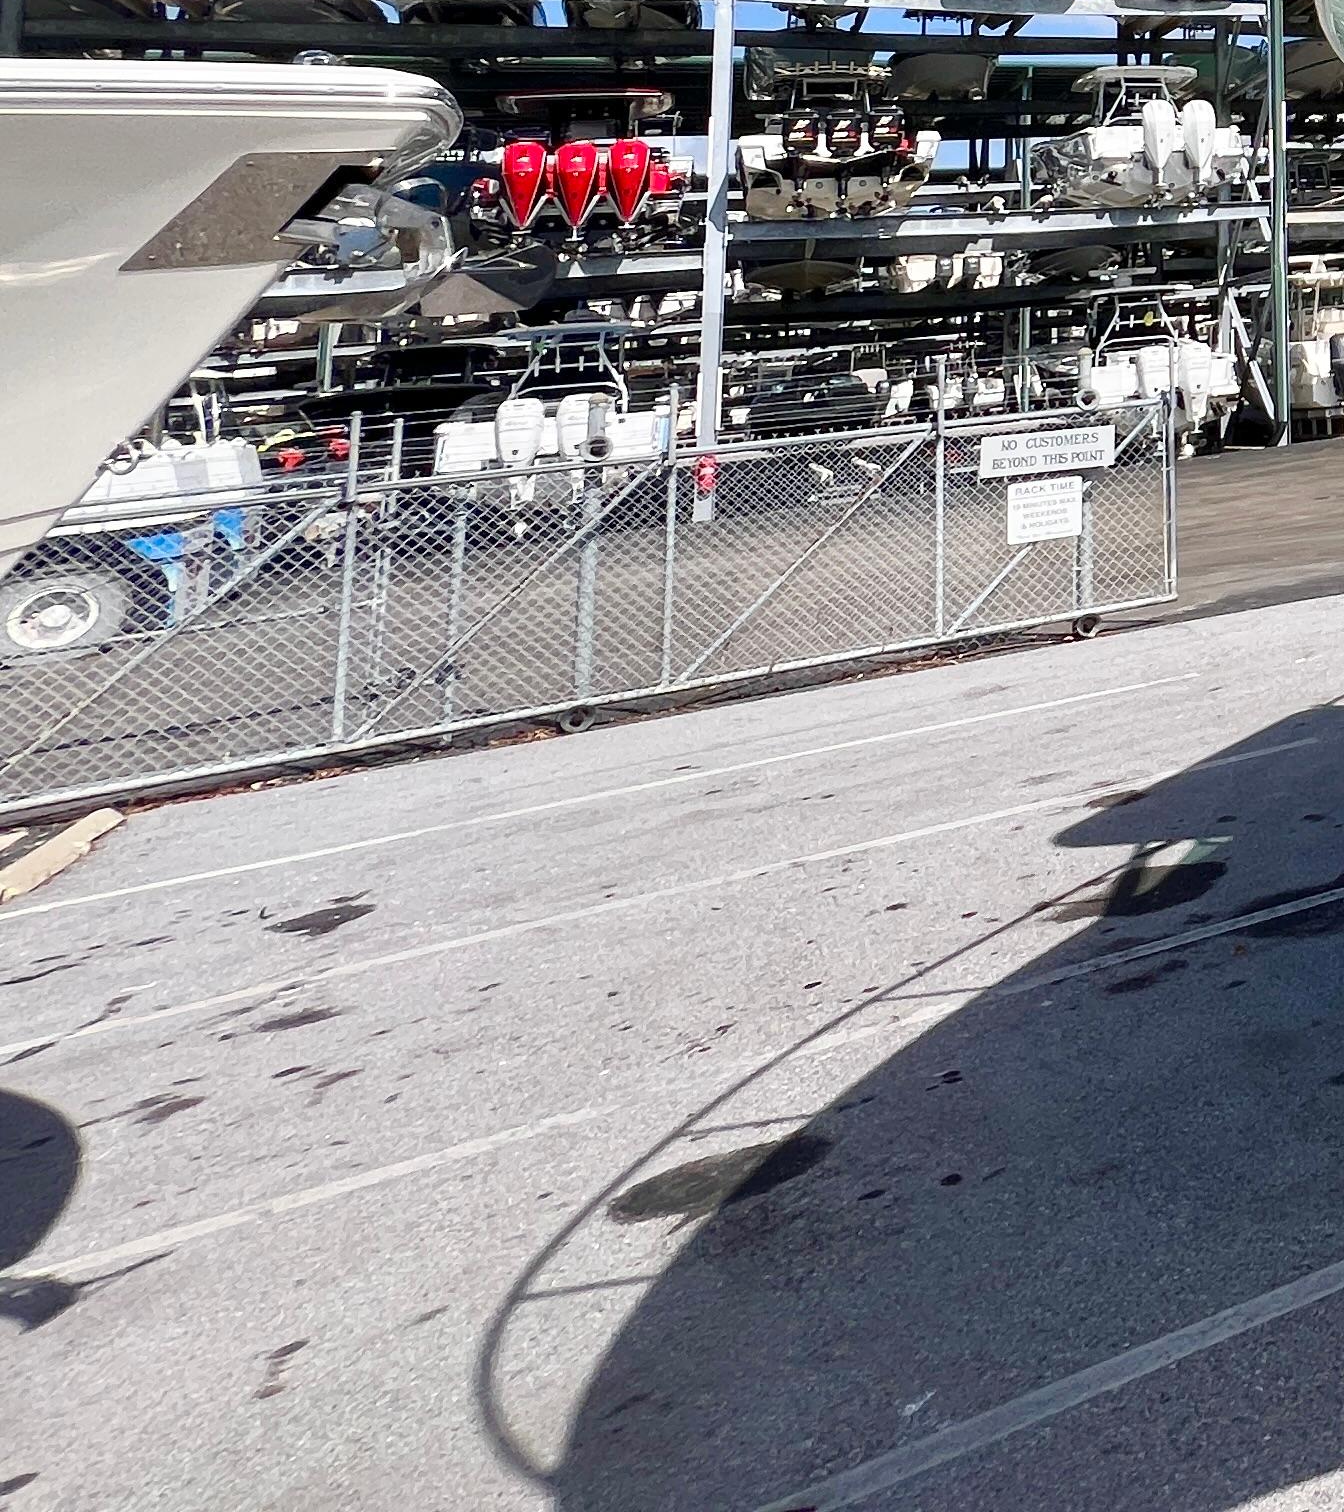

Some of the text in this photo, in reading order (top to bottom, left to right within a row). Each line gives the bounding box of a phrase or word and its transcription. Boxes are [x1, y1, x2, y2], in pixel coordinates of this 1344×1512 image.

[1001, 433, 1099, 452] NO CUSTOMERS
[992, 450, 1105, 470] BEYOND THIS POINT
[1015, 481, 1075, 496] RACK TIME
